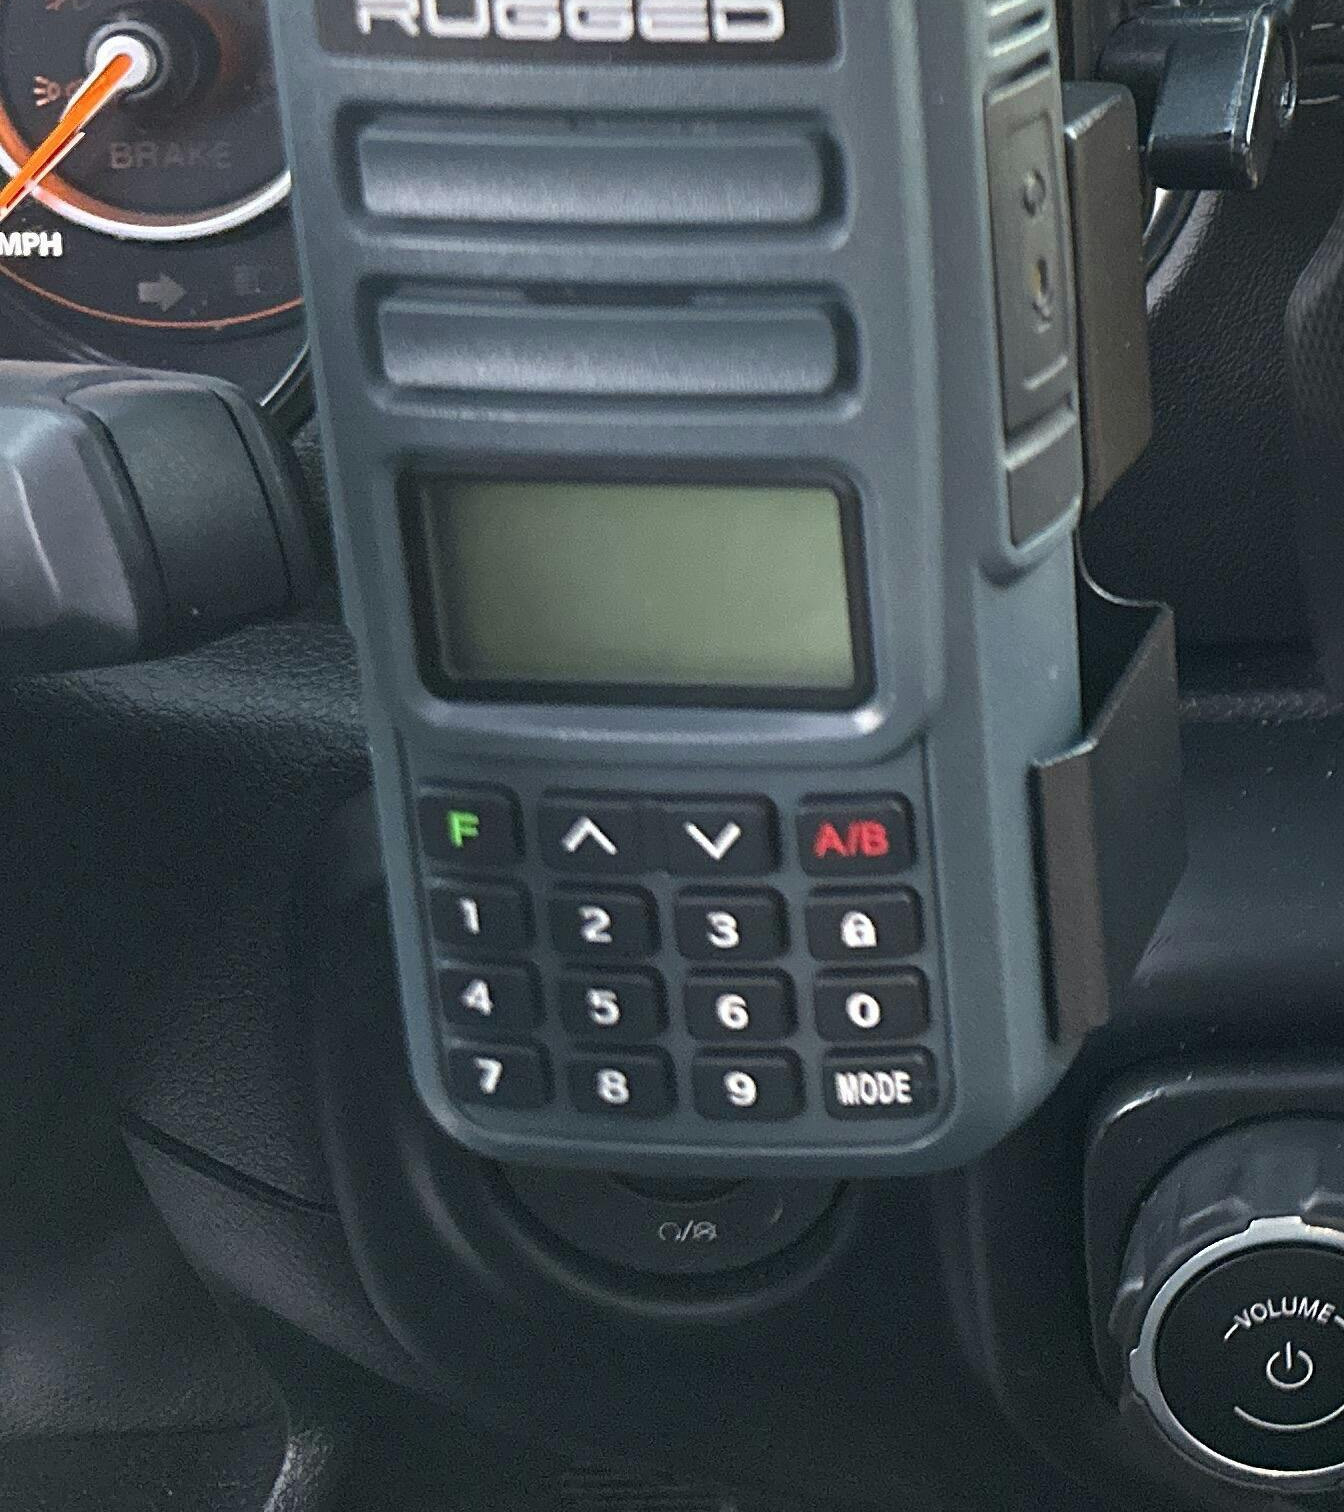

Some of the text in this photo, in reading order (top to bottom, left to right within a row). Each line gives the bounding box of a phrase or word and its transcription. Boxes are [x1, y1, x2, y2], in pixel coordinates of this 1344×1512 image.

[109, 141, 232, 170] BRAKE
[0, 231, 63, 257] MPH
[446, 810, 480, 848] F
[812, 819, 890, 859] A/B
[458, 897, 481, 935] 1
[579, 906, 613, 944] 2
[706, 911, 740, 949] 3
[461, 979, 493, 1017] 4
[586, 989, 621, 1026] 5
[716, 993, 750, 1030] 6
[845, 992, 881, 1029] 0
[473, 1056, 502, 1094] 7
[598, 1068, 630, 1105] 8
[725, 1071, 758, 1107] 9
[834, 1070, 913, 1106] MODE
[1233, 1296, 1336, 1331] VOLUME
